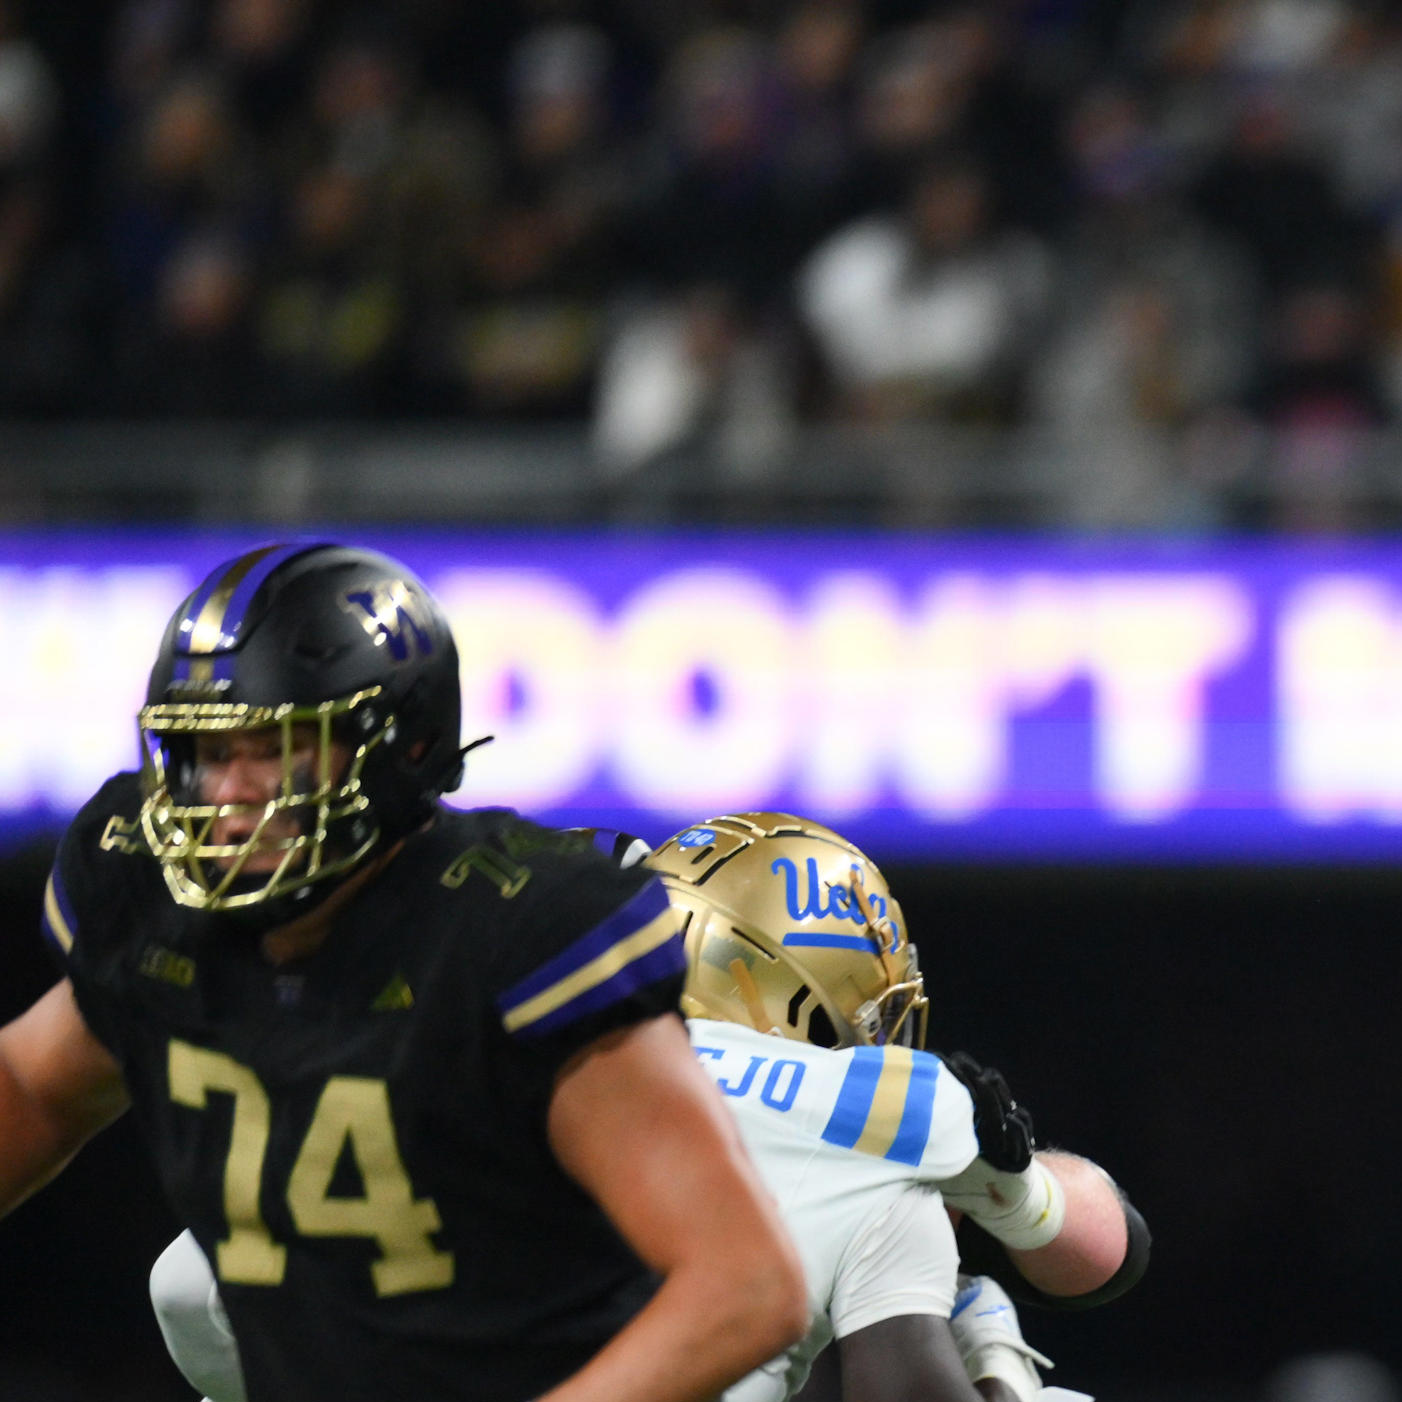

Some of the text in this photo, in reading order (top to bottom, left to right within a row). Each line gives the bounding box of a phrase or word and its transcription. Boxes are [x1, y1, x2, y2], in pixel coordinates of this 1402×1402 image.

[340, 583, 434, 663] W
[440, 567, 1256, 826] DON'T
[166, 1038, 456, 1298] 74
